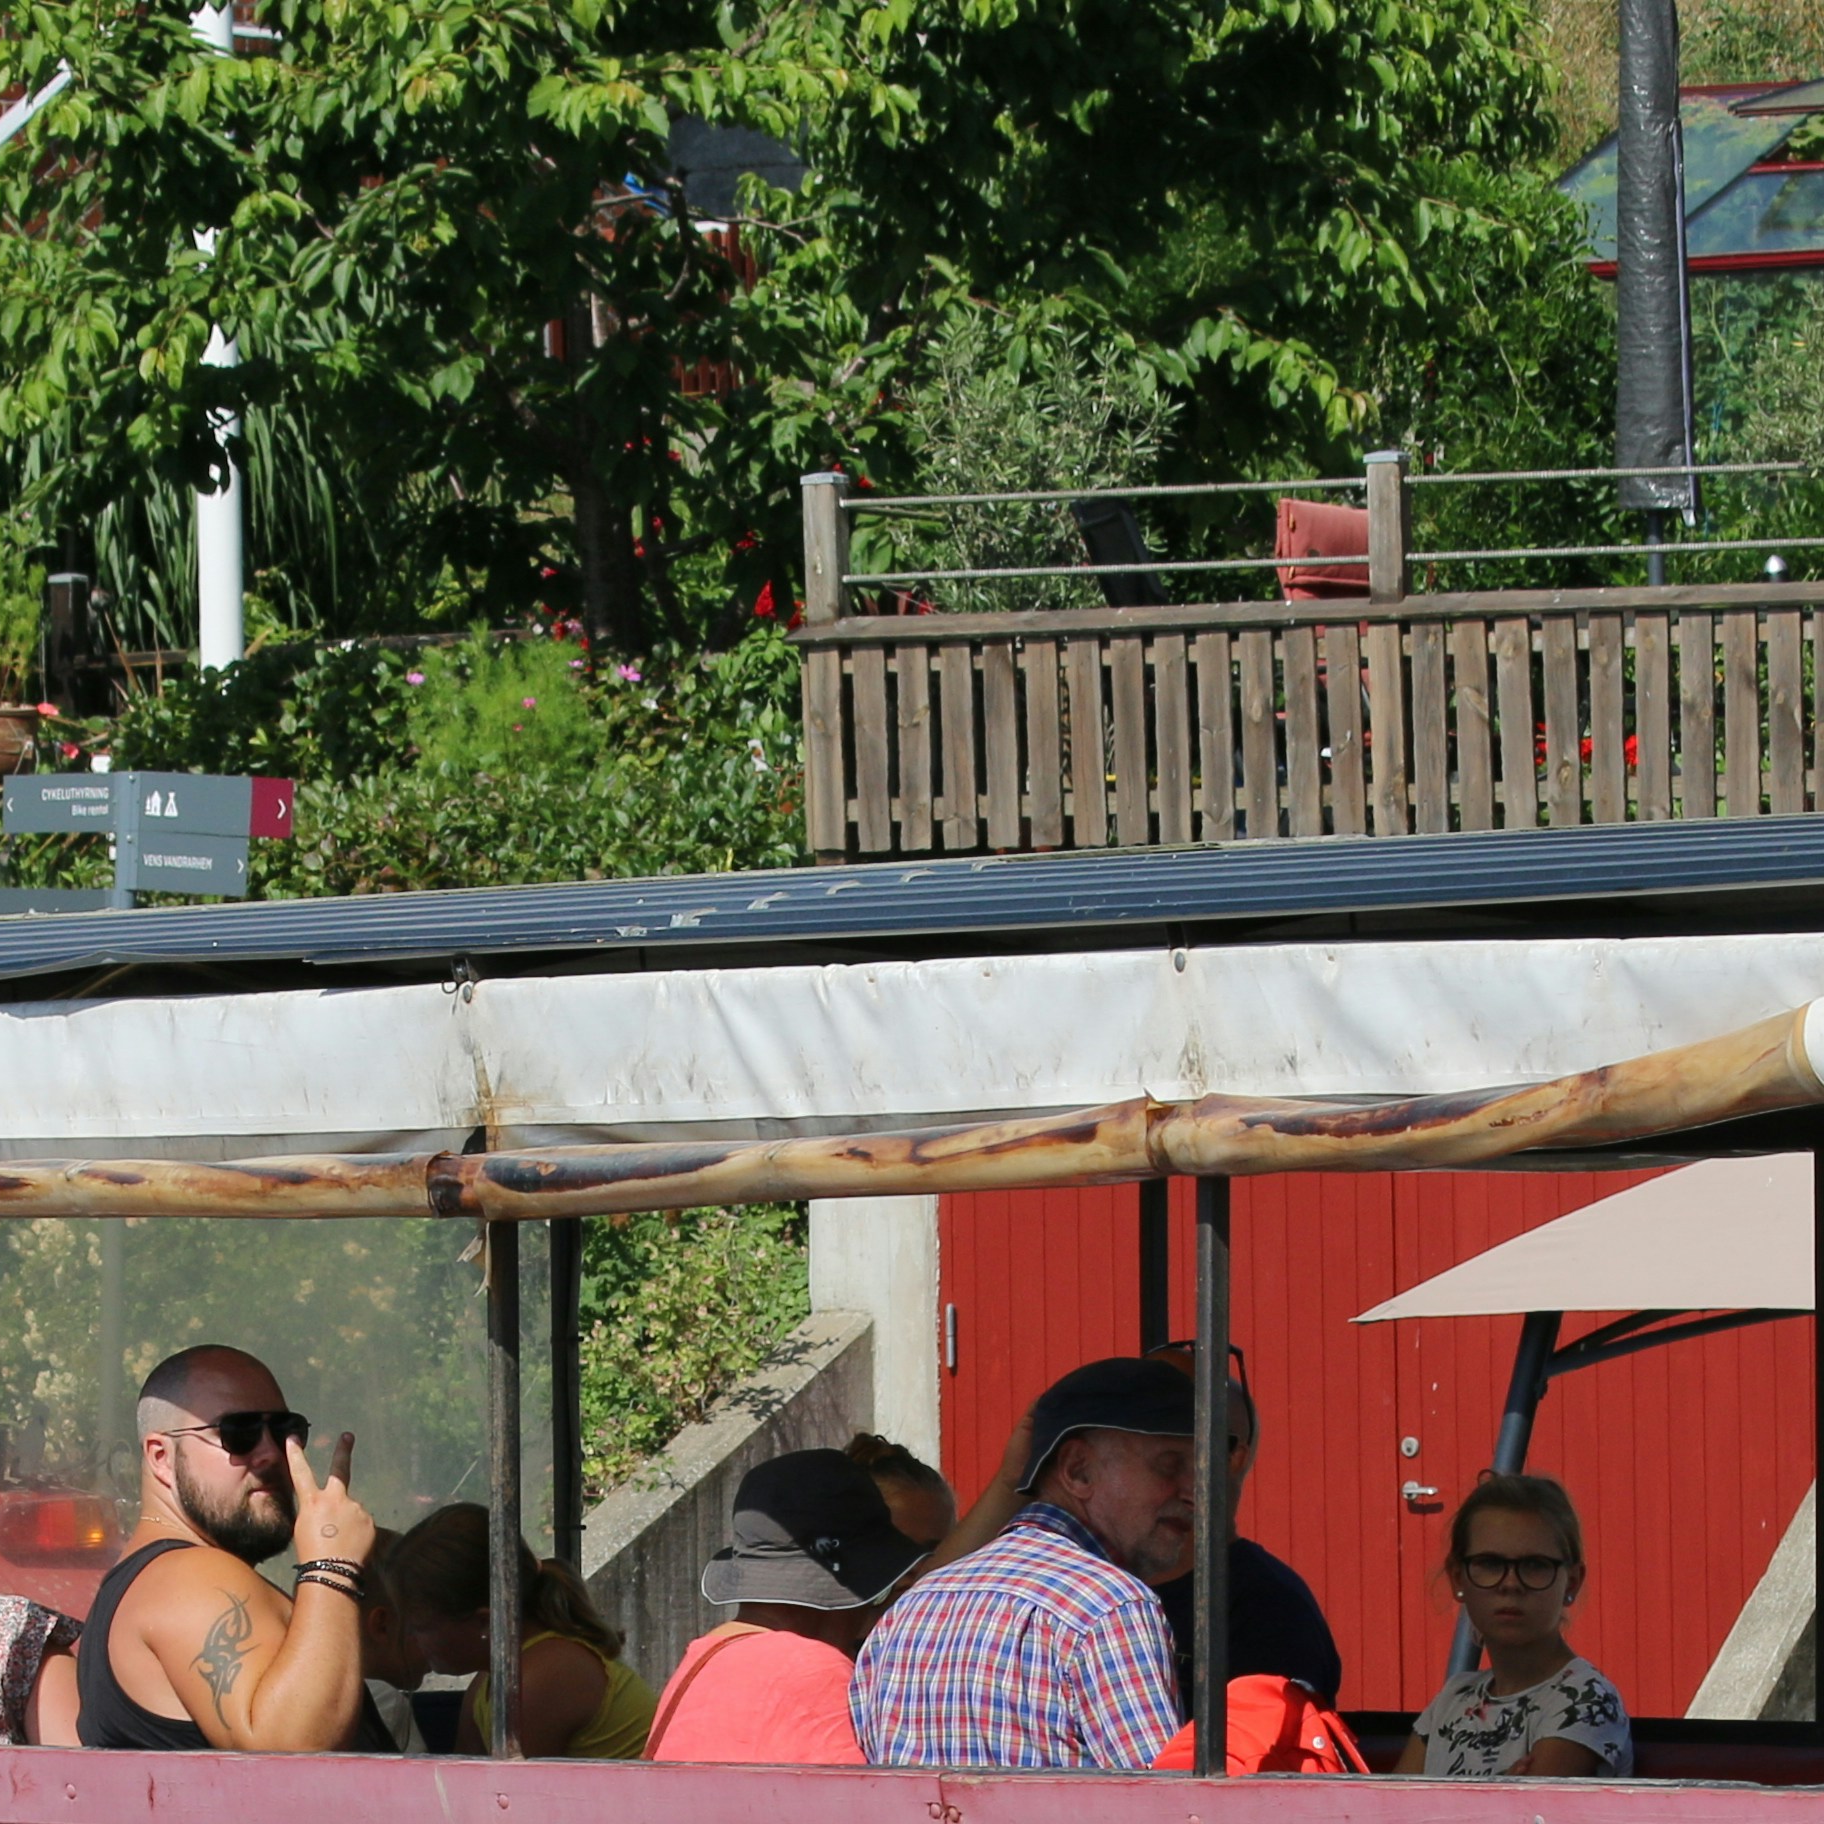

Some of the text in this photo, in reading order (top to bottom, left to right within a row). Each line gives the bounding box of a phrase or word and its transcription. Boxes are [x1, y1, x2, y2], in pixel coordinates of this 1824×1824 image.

[40, 786, 109, 801] CYKELUTHYRNING
[143, 853, 213, 871] VENS VANDRARHEM
